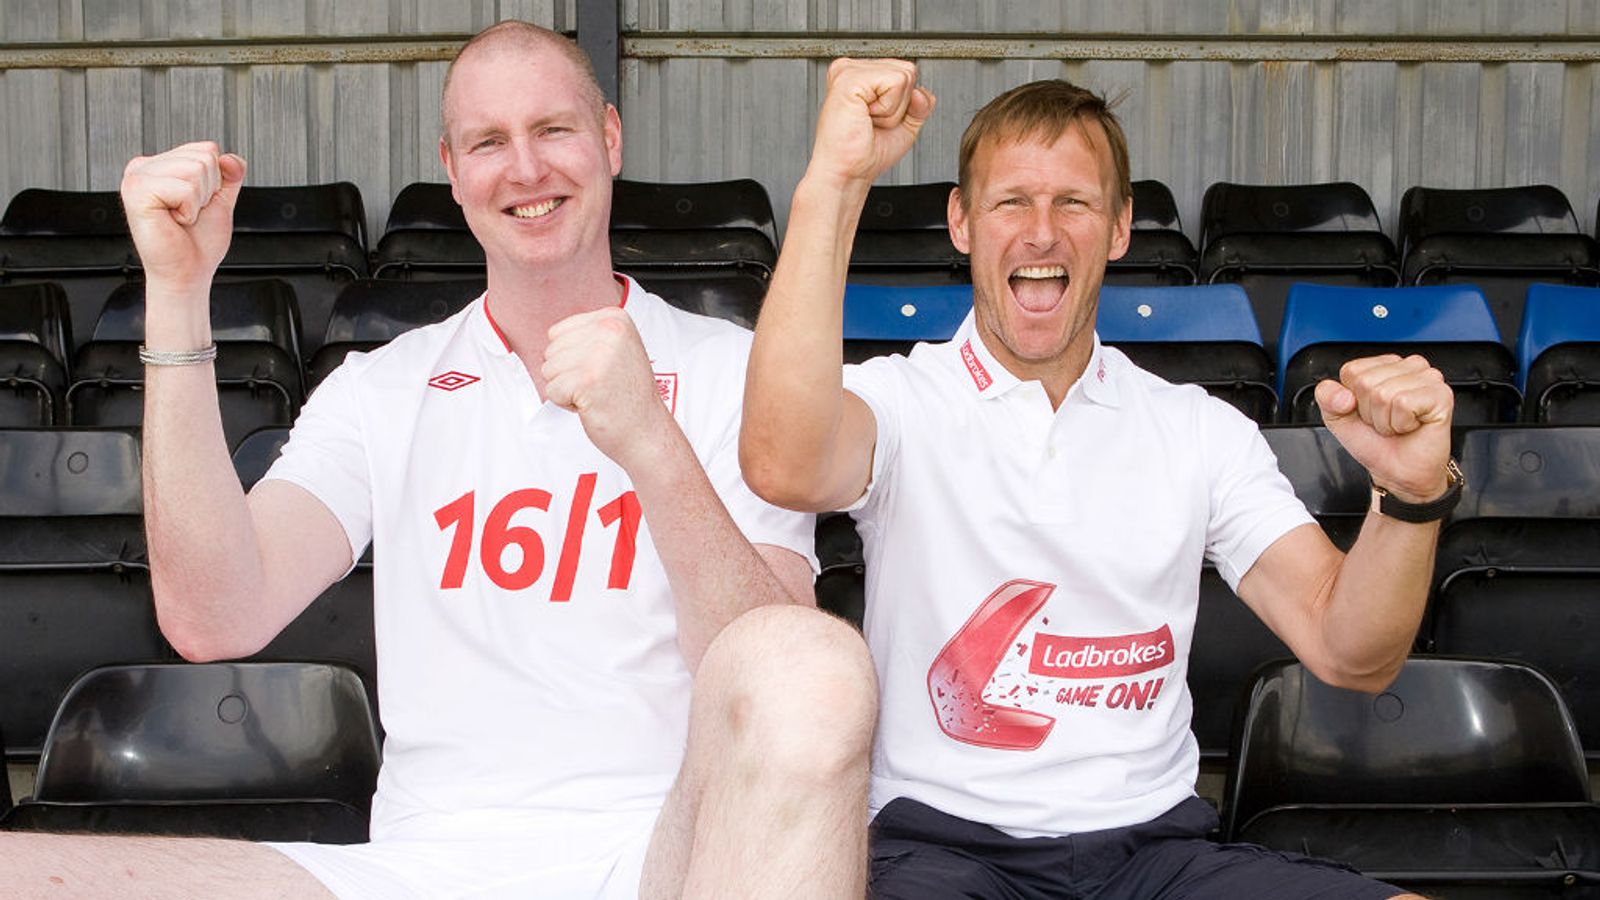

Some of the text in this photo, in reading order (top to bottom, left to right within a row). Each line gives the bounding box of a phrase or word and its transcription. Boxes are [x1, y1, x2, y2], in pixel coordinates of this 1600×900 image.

[433, 472, 643, 602] 16/1
[1043, 641, 1166, 668] Ladbrokes
[1056, 677, 1165, 710] GAME ON!
